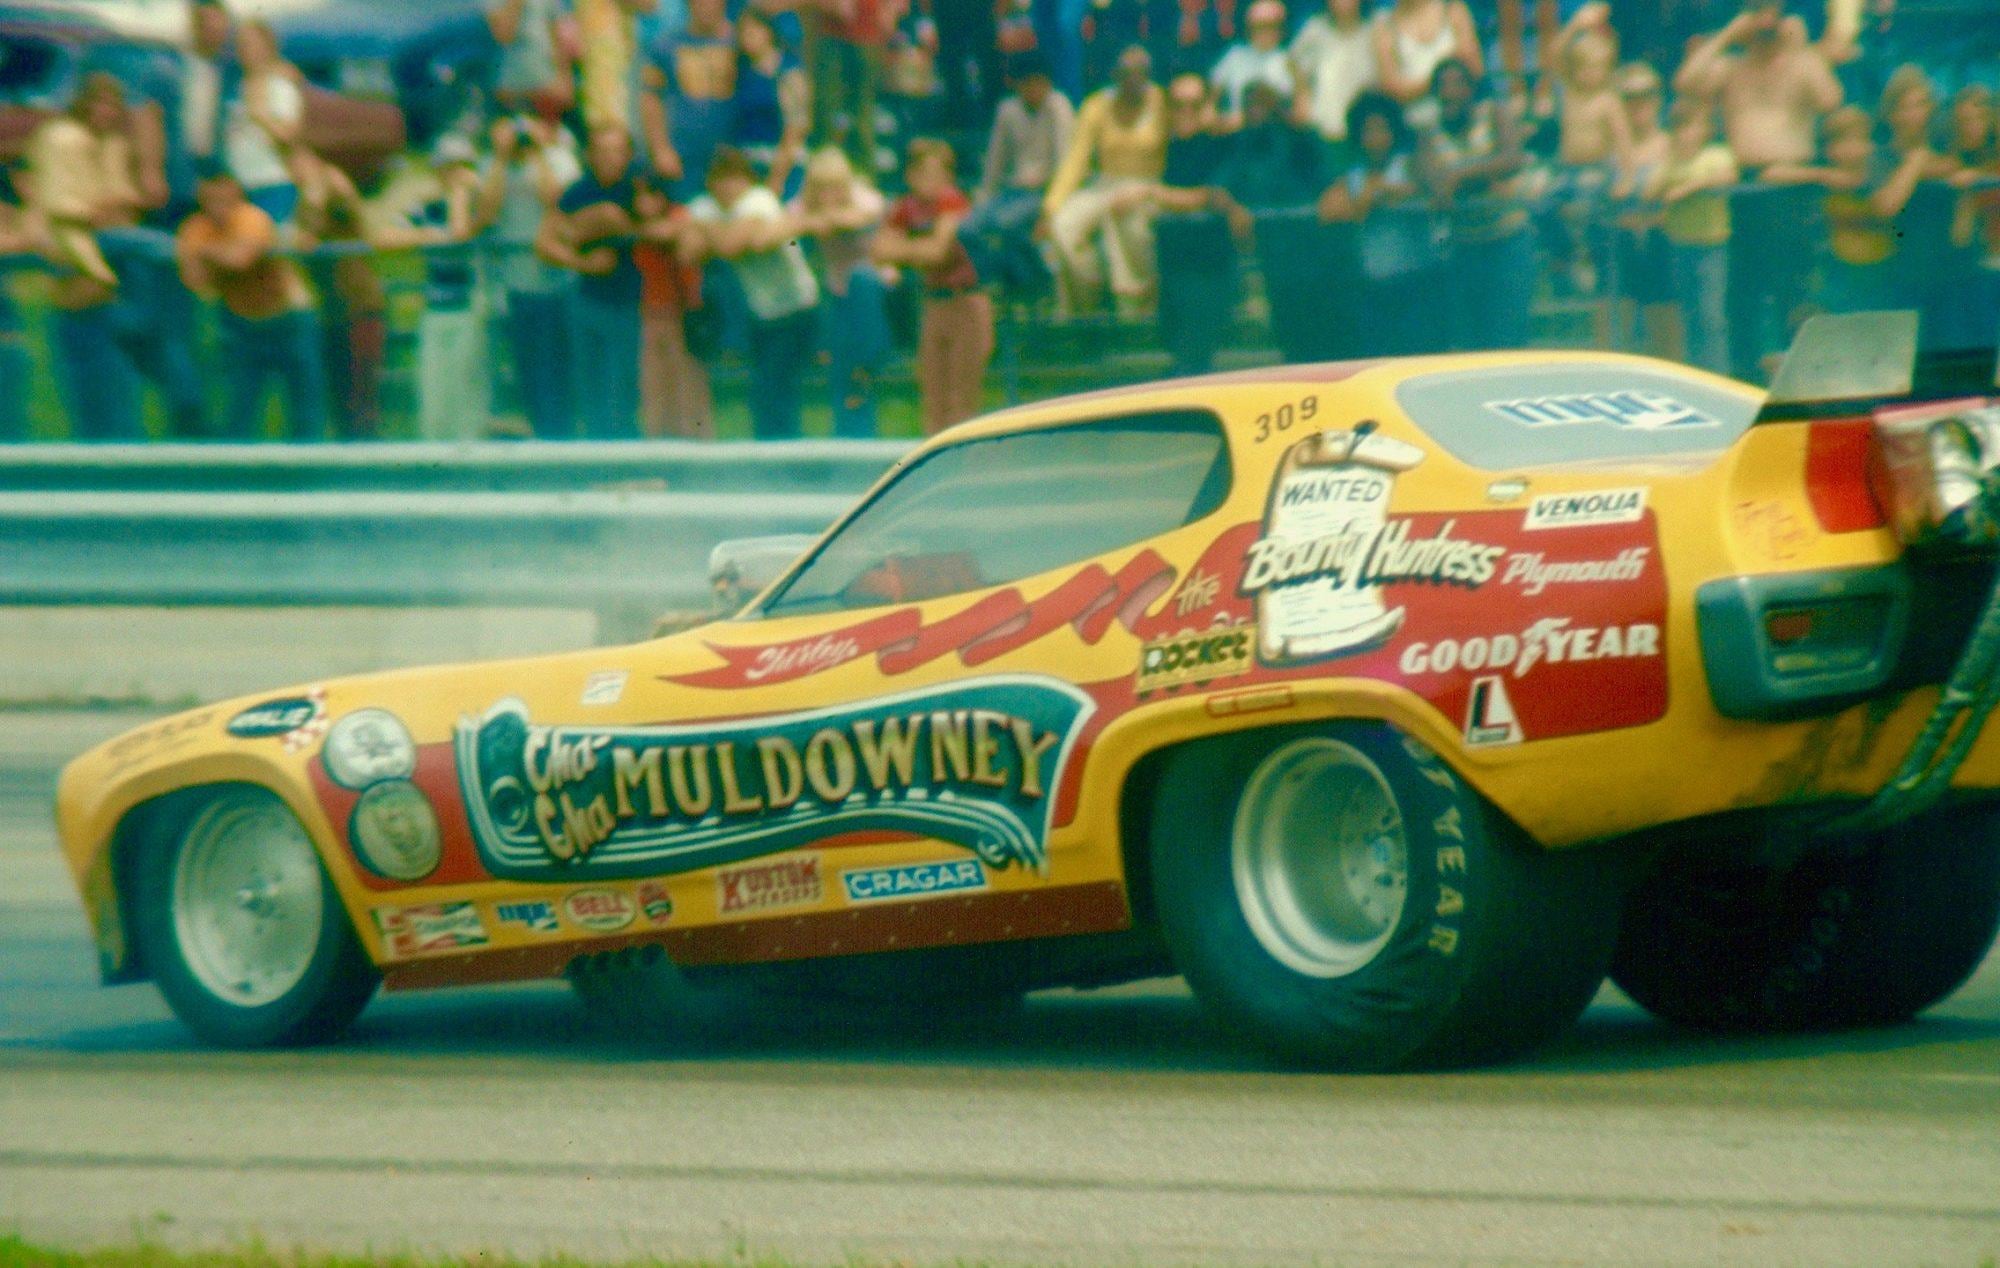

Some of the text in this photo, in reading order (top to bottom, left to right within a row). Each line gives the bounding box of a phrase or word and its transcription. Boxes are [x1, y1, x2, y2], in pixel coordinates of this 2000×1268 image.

[1255, 394, 1318, 443] 309
[1282, 478, 1383, 507] WANTED
[1534, 492, 1641, 518] VENOLIA
[1241, 520, 1368, 594] Bounty
[1360, 518, 1504, 586] Huntress
[1501, 546, 1650, 596] Plymouth
[1399, 617, 1660, 678] GOODYEAR
[613, 709, 1059, 818] MULDOWNEY
[534, 792, 616, 859] Cha
[850, 862, 978, 897] CRAGAR
